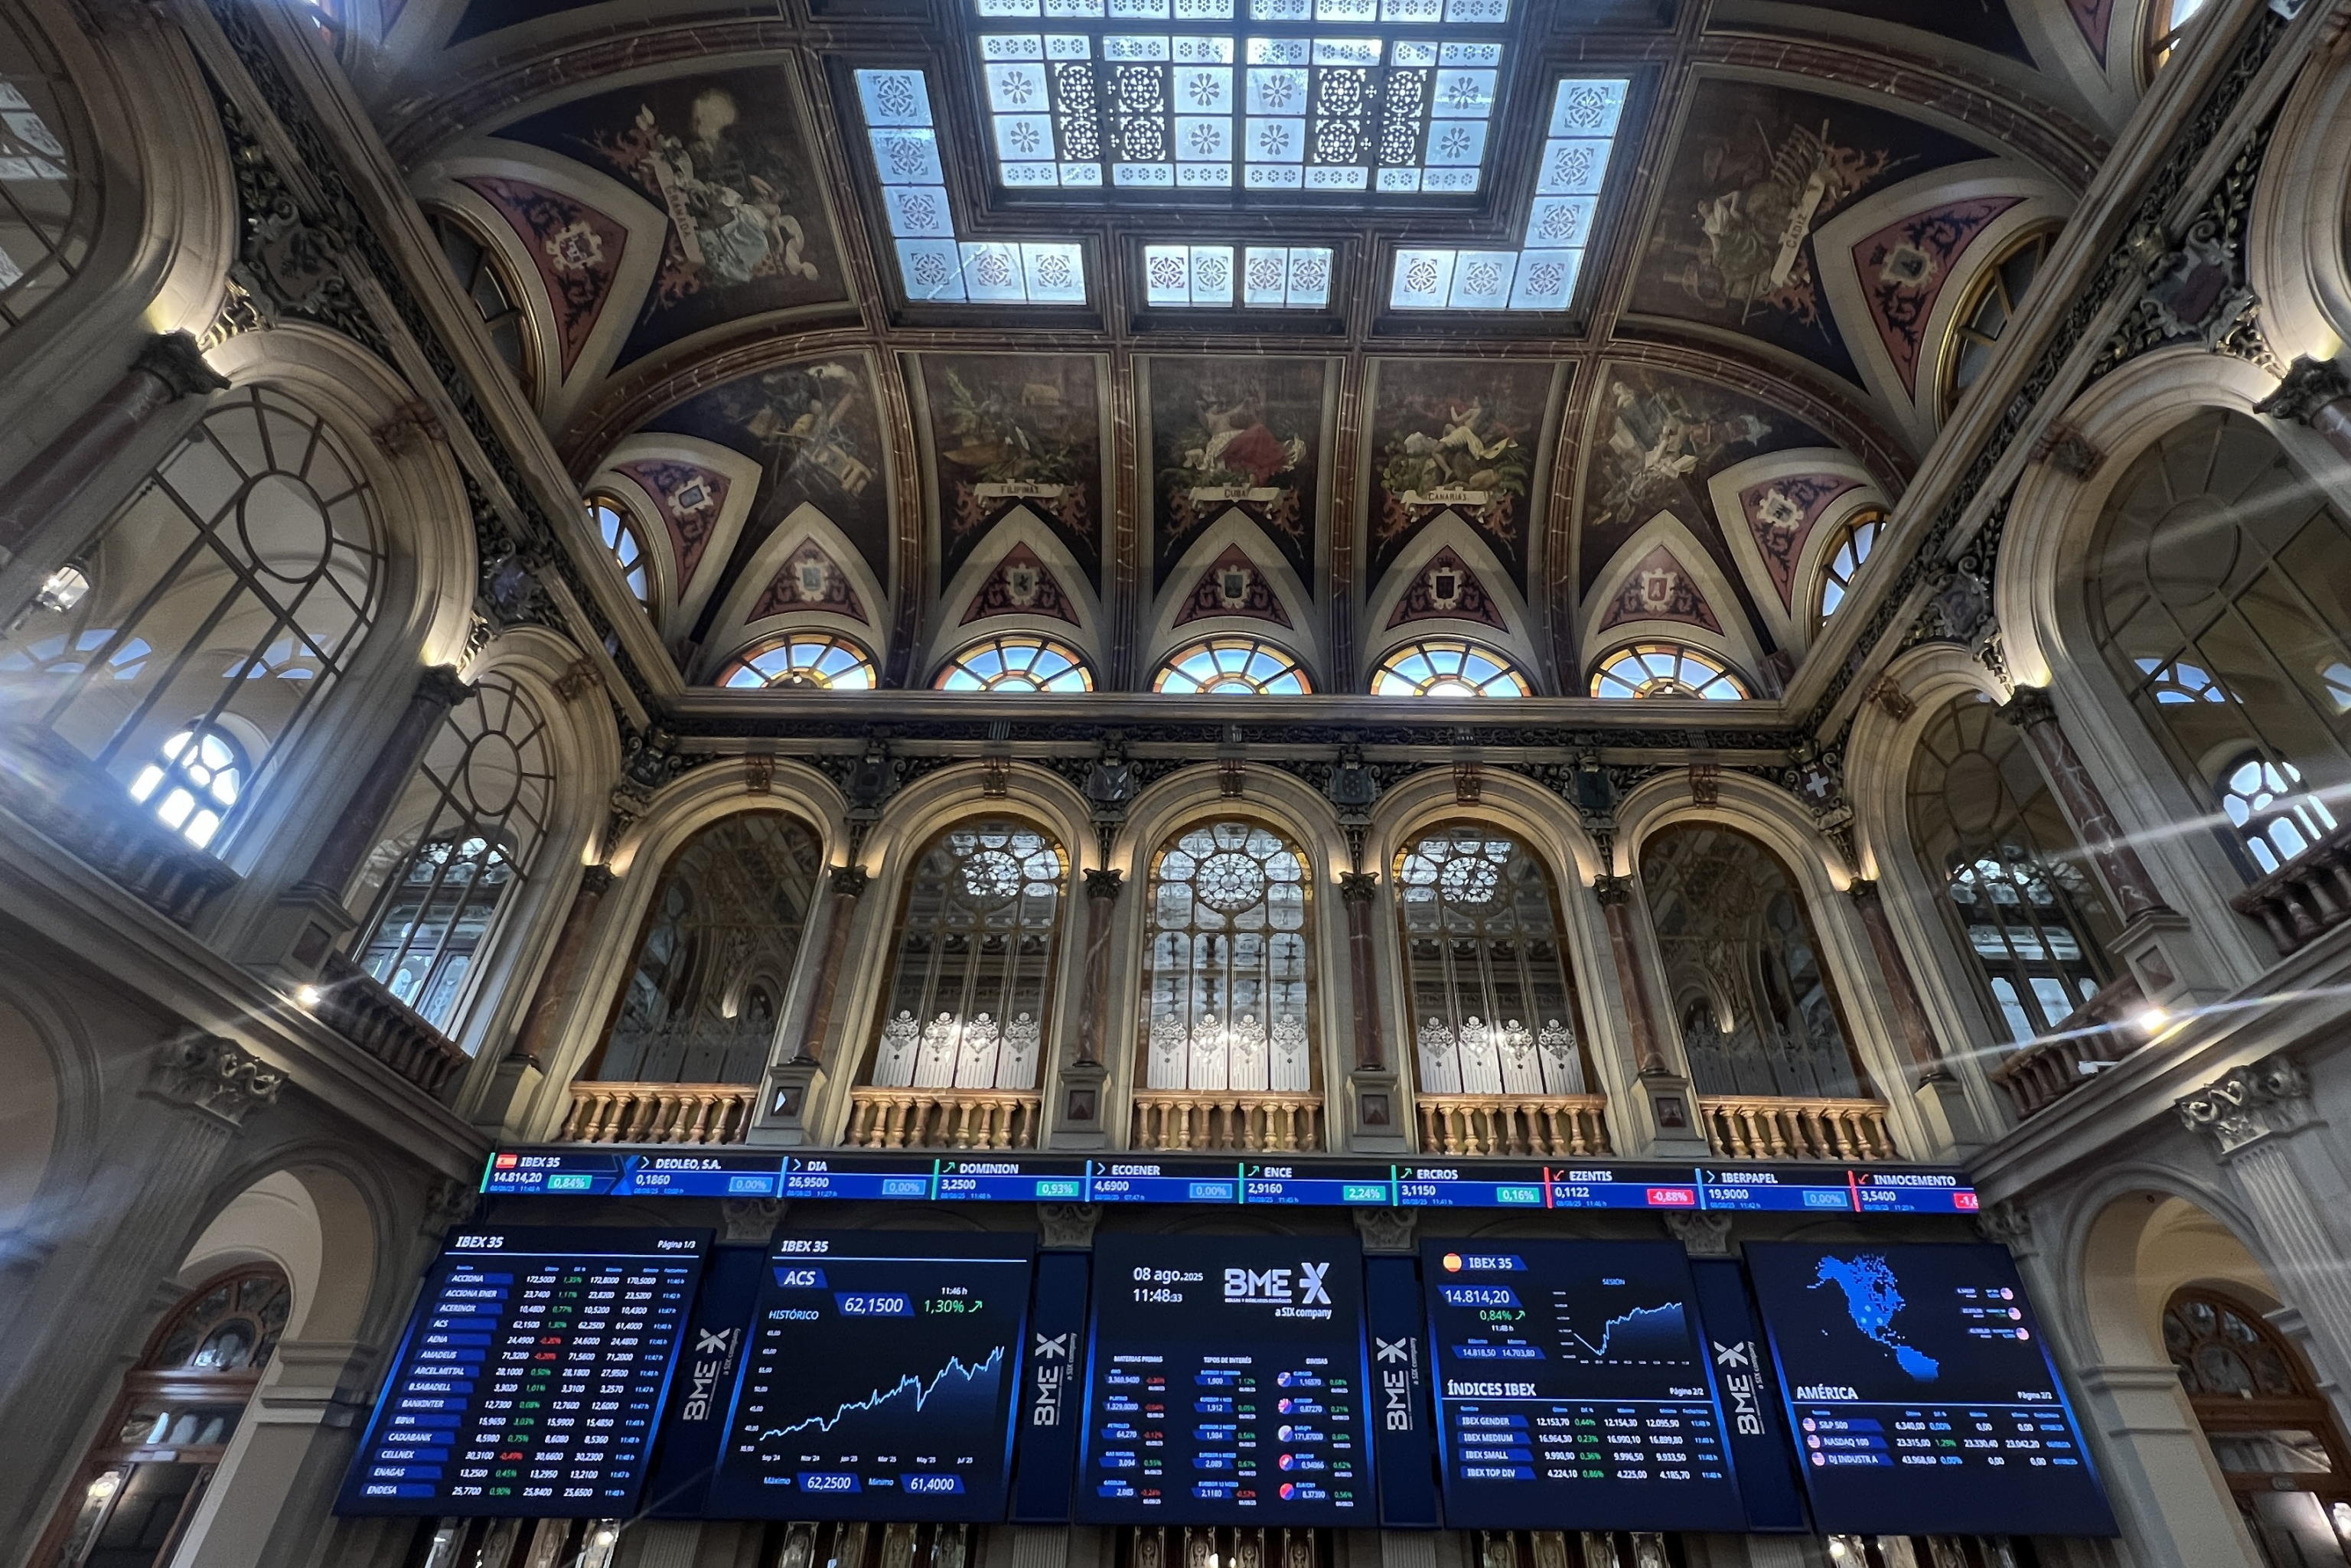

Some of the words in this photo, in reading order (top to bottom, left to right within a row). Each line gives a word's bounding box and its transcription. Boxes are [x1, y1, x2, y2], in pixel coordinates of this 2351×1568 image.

[520, 1157, 546, 1167] IBEX
[546, 1157, 560, 1167] 35
[656, 1159, 699, 1170] DEOLEO,
[702, 1159, 721, 1170] S.A.
[807, 1162, 827, 1172] DIA
[960, 1164, 1019, 1174] DOMINION
[1112, 1165, 1160, 1175] ECOENER
[1264, 1167, 1292, 1178] ENCE
[1417, 1169, 1458, 1179] ERCROS
[493, 1172, 542, 1184] 14.814,20
[636, 1175, 670, 1185] 0,1860
[1570, 1171, 1612, 1182] EZENTIS
[1722, 1172, 1779, 1184] IBERPAPEL
[1874, 1175, 1956, 1186] INMOCEMENTO
[553, 1177, 585, 1188] 0,84%
[735, 1178, 765, 1190] 0,00%
[789, 1177, 829, 1188] 26,9500
[889, 1182, 919, 1193] 0,00%
[941, 1179, 976, 1190] 3,2500
[1094, 1181, 1129, 1192] 4,6900
[1042, 1183, 1073, 1195] 0,93%
[1196, 1185, 1226, 1196] 0,00%
[1248, 1183, 1283, 1194] 2,9160
[1349, 1188, 1380, 1199] 2,24%
[1401, 1185, 1436, 1197] 3,1150
[1555, 1187, 1590, 1198] 0,1122
[1709, 1188, 1749, 1200] 19,9000
[1502, 1190, 1533, 1201] 0,16%
[1653, 1191, 1687, 1201] -0,88%
[1810, 1194, 1841, 1205] 0,00%
[1861, 1191, 1896, 1201] 3,5400
[455, 1237, 487, 1248] IBEX
[487, 1237, 504, 1248] 35
[657, 1240, 682, 1250] Página
[781, 1240, 812, 1252] IBEX
[813, 1241, 829, 1252] 35
[1469, 1257, 1496, 1269] IBEX
[1498, 1258, 1512, 1269] 35
[784, 1271, 816, 1285] ACS
[1133, 1267, 1151, 1280] 08
[1446, 1289, 1509, 1305] 14.814,20
[845, 1298, 903, 1314] 62,1500
[924, 1300, 964, 1314] 1,30%
[769, 1309, 819, 1319] HISTÓRICO
[1282, 1307, 1295, 1316] SIX
[1296, 1309, 1332, 1319] company
[1480, 1310, 1511, 1321] 0,84%
[1448, 1379, 1502, 1395] ÍNDICES
[1505, 1384, 1536, 1396] IBEX
[1670, 1387, 1692, 1397] Página
[1797, 1384, 1858, 1400] AMÉRICA
[1824, 1439, 1855, 1447] NASDAQ
[1484, 1451, 1508, 1459] SMALL
[807, 1476, 850, 1489] 62,2500
[911, 1478, 954, 1491] 61,4000
